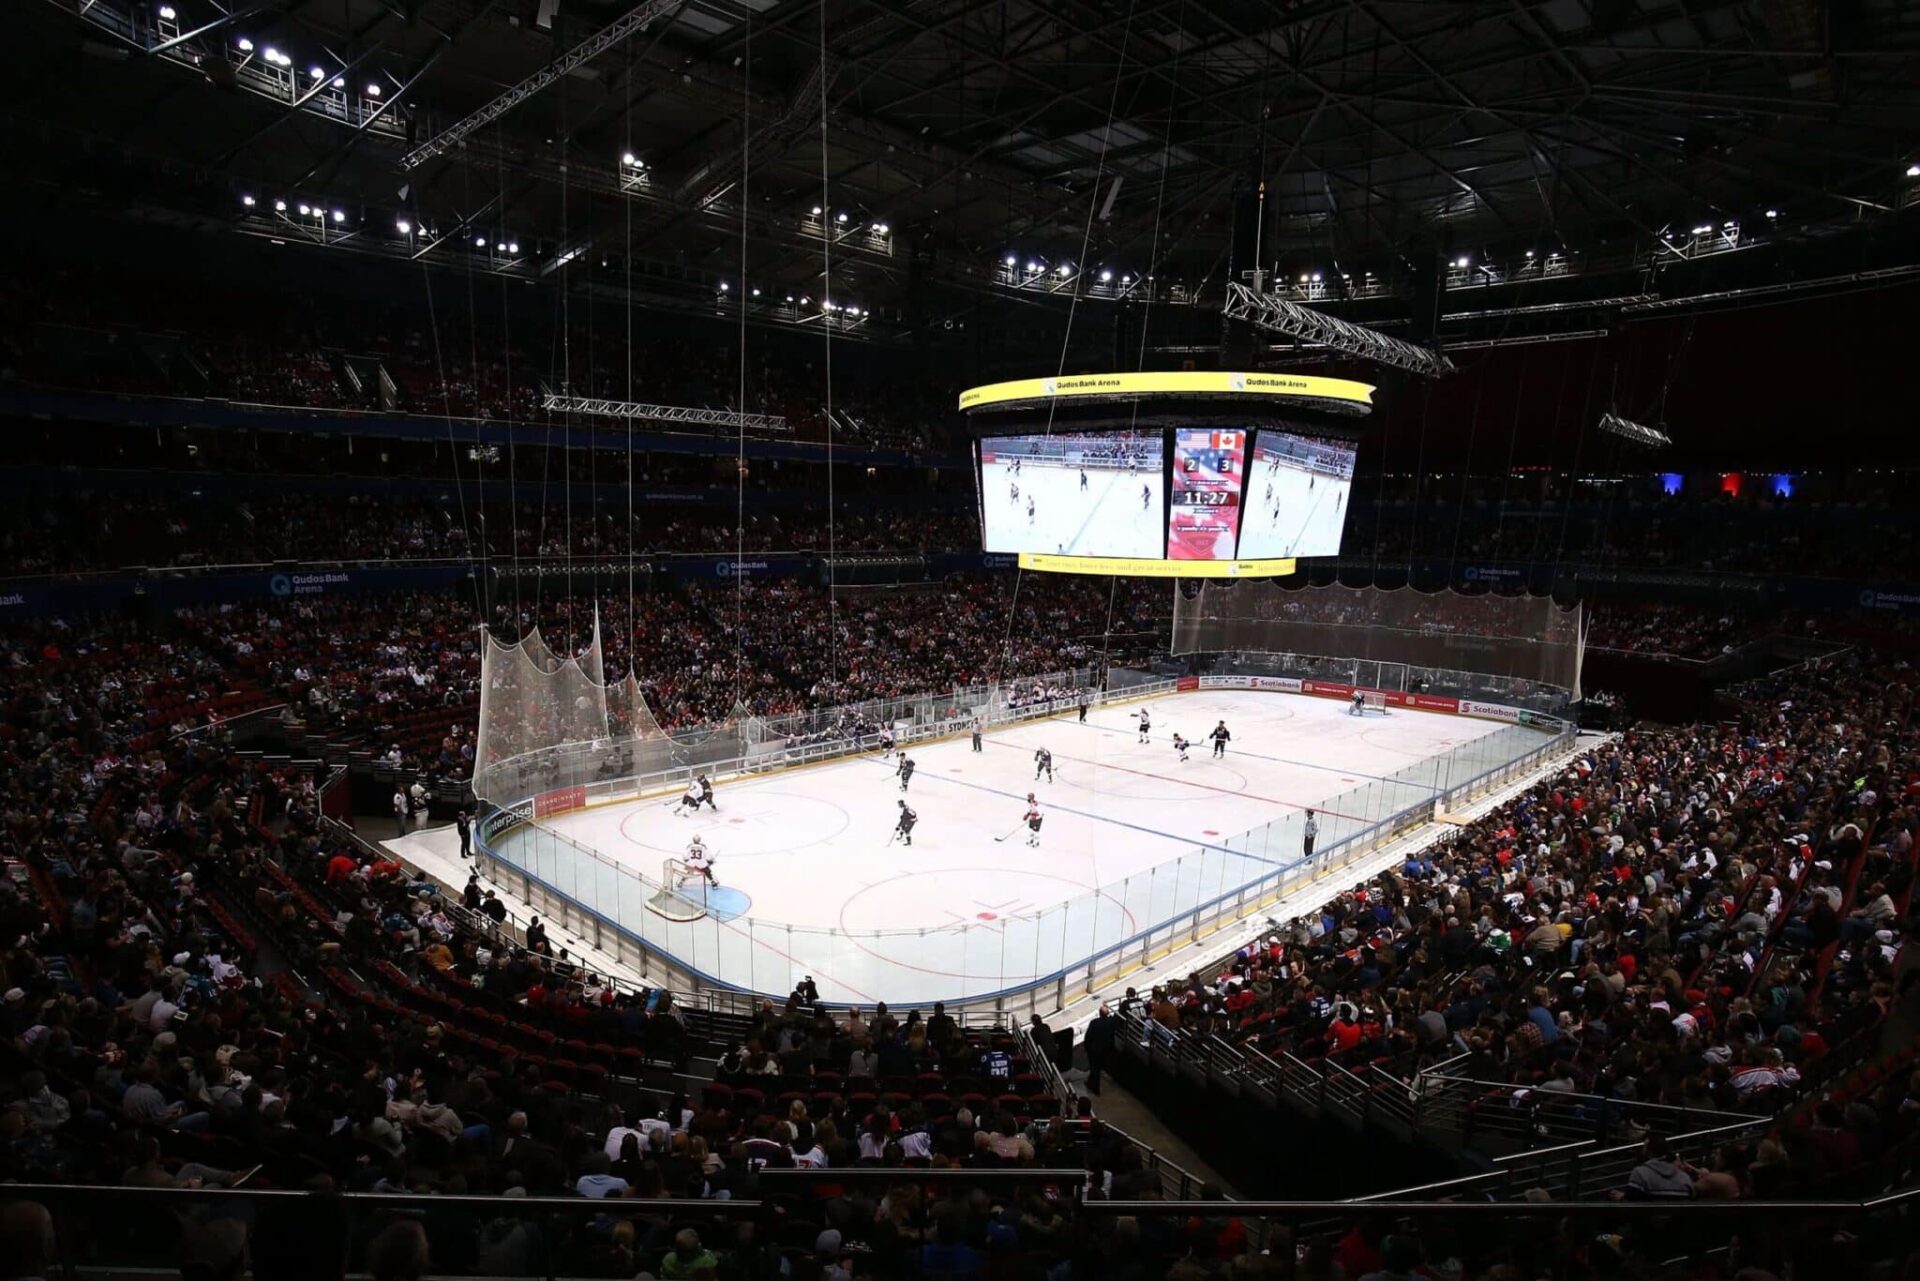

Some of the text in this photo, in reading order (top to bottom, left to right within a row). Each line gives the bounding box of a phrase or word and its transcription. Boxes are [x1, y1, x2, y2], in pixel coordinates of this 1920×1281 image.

[1056, 379, 1120, 389] Qudos Bank Arena
[1246, 378, 1307, 389] Qudos Bank Arena
[1187, 459, 1196, 471] 2
[1221, 459, 1230, 471] 3
[1184, 491, 1229, 504] 11:27
[292, 571, 350, 584] Qudos Bank
[294, 584, 323, 593] Arena
[0, 592, 26, 606] ank
[1260, 679, 1300, 689] Scotiabank
[1473, 705, 1518, 719] Scotiabank
[690, 849, 703, 860] 33
